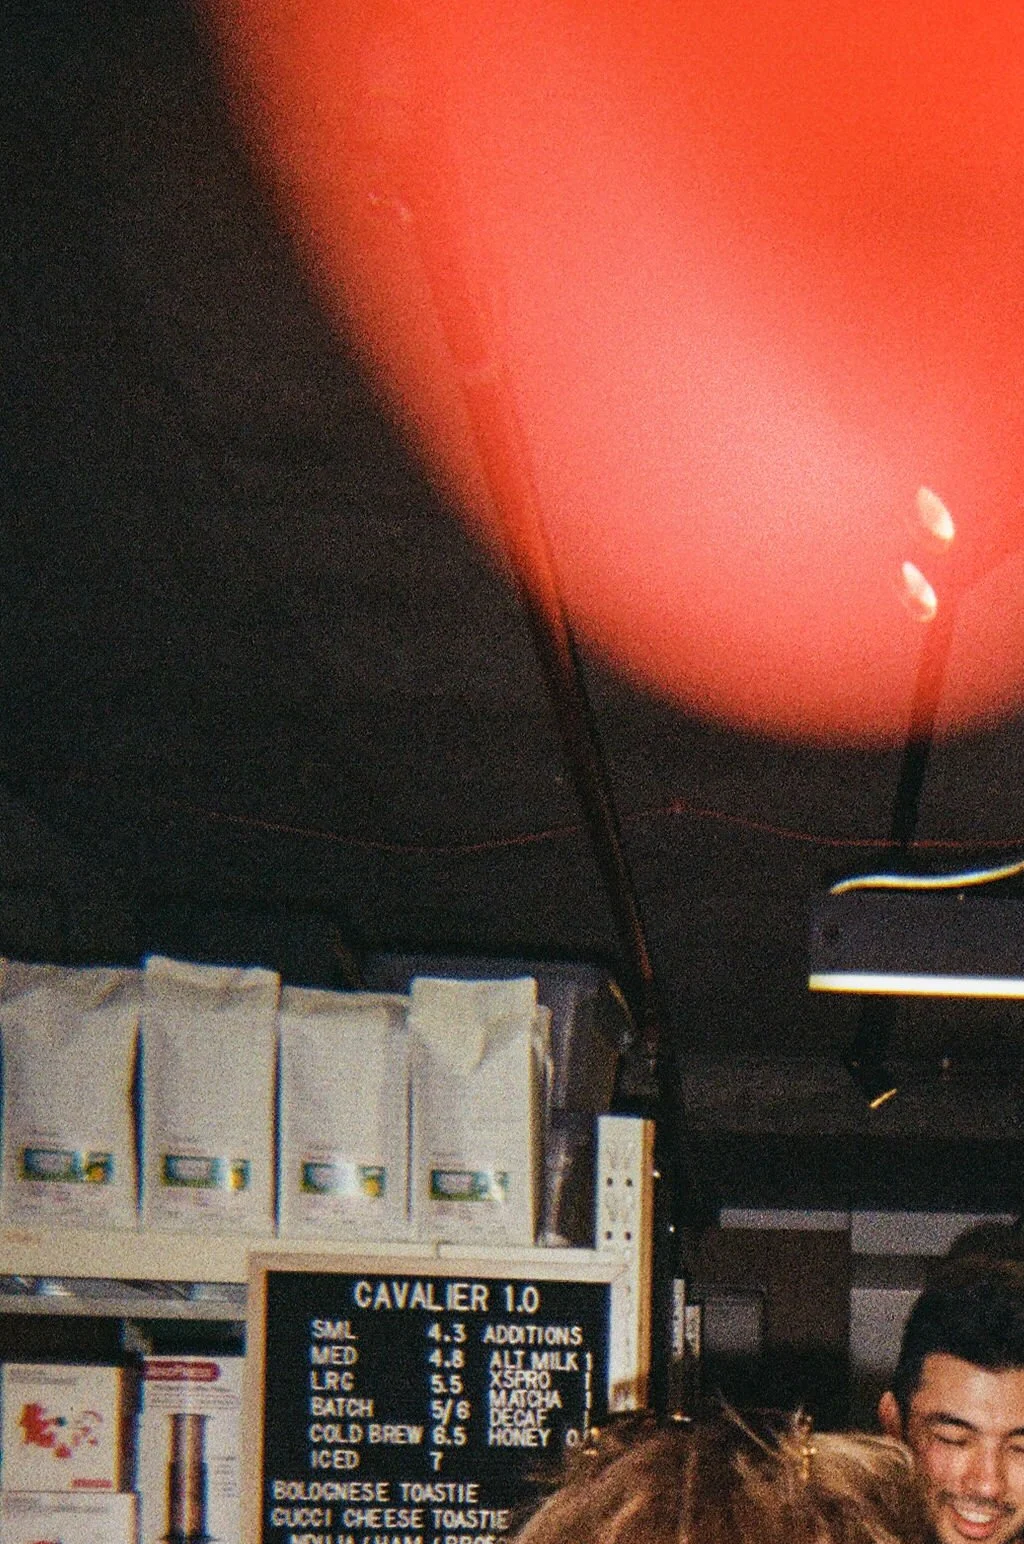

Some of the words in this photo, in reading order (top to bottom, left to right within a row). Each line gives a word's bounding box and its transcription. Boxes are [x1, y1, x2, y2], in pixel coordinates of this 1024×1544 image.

[354, 1280, 489, 1312] CAVALIER
[504, 1284, 541, 1314] 1.0
[312, 1319, 358, 1340] SML
[428, 1323, 467, 1343] 4.3
[483, 1325, 583, 1346] ADDITIONS
[311, 1346, 359, 1365] MED
[428, 1349, 466, 1369] 4.8
[490, 1350, 525, 1370] ALT
[531, 1351, 579, 1371] MILK
[311, 1370, 356, 1391] LRG
[431, 1374, 464, 1394] 5.5
[311, 1396, 375, 1418] BATCH
[488, 1389, 563, 1408] MATCHA
[489, 1408, 548, 1427] DECAF
[309, 1423, 364, 1444] COLD
[369, 1423, 425, 1445] BREW
[432, 1424, 468, 1446] 6.5
[488, 1427, 551, 1447] HONEY
[311, 1449, 360, 1470] ICED
[429, 1451, 444, 1472] 7
[272, 1480, 390, 1502] BOLOGNESE
[400, 1482, 480, 1504] TOASTIE
[343, 1508, 424, 1529] CHEESE
[432, 1510, 512, 1531] TOASTIE
